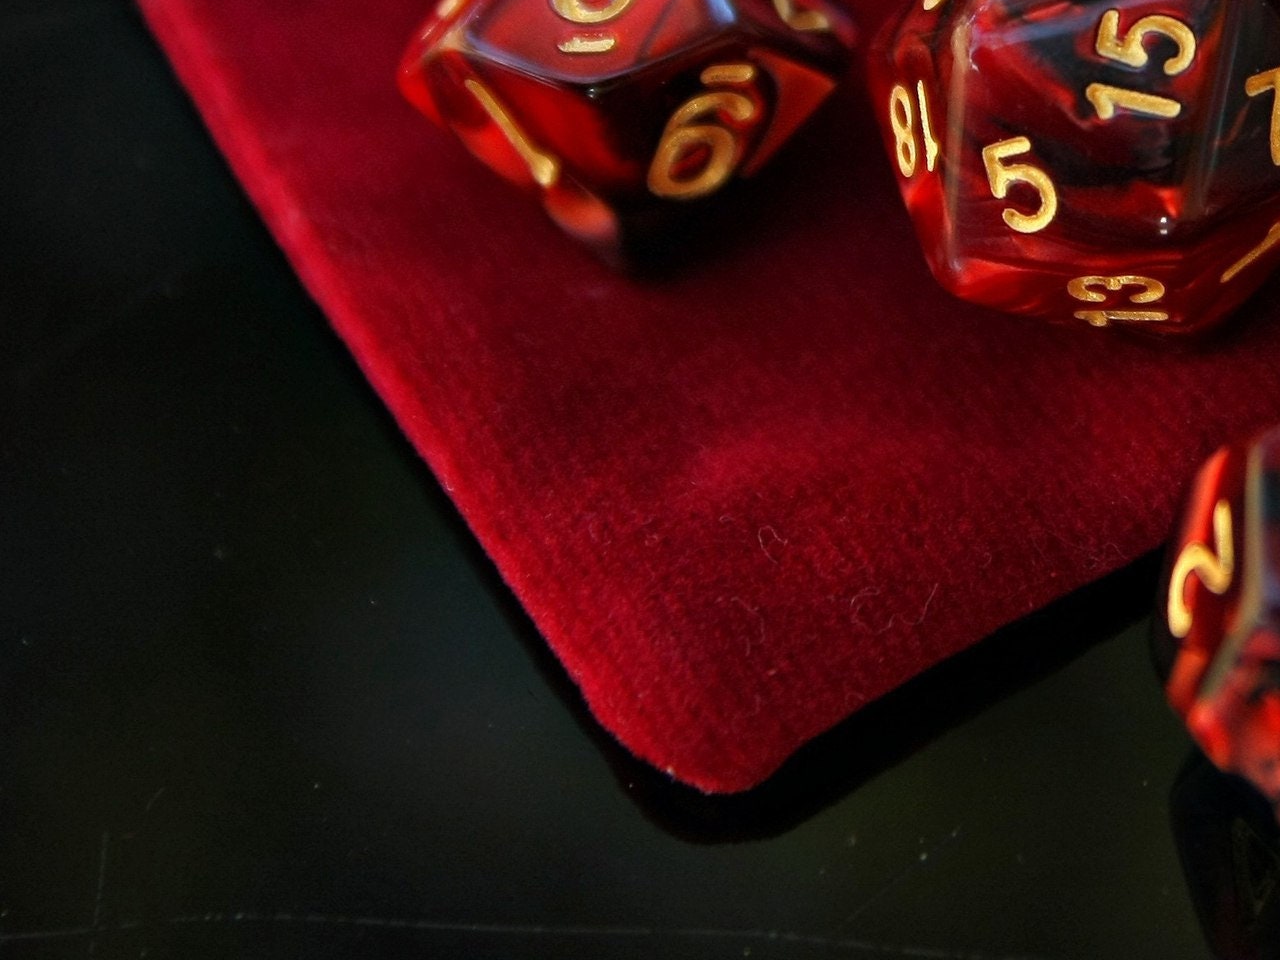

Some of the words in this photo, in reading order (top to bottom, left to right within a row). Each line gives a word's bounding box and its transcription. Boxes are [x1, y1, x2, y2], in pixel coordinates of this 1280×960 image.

[1085, 8, 1196, 120] 15
[889, 79, 938, 177] 18
[982, 136, 1057, 233] 5
[1067, 275, 1168, 326] 13
[1168, 498, 1234, 638] 2
